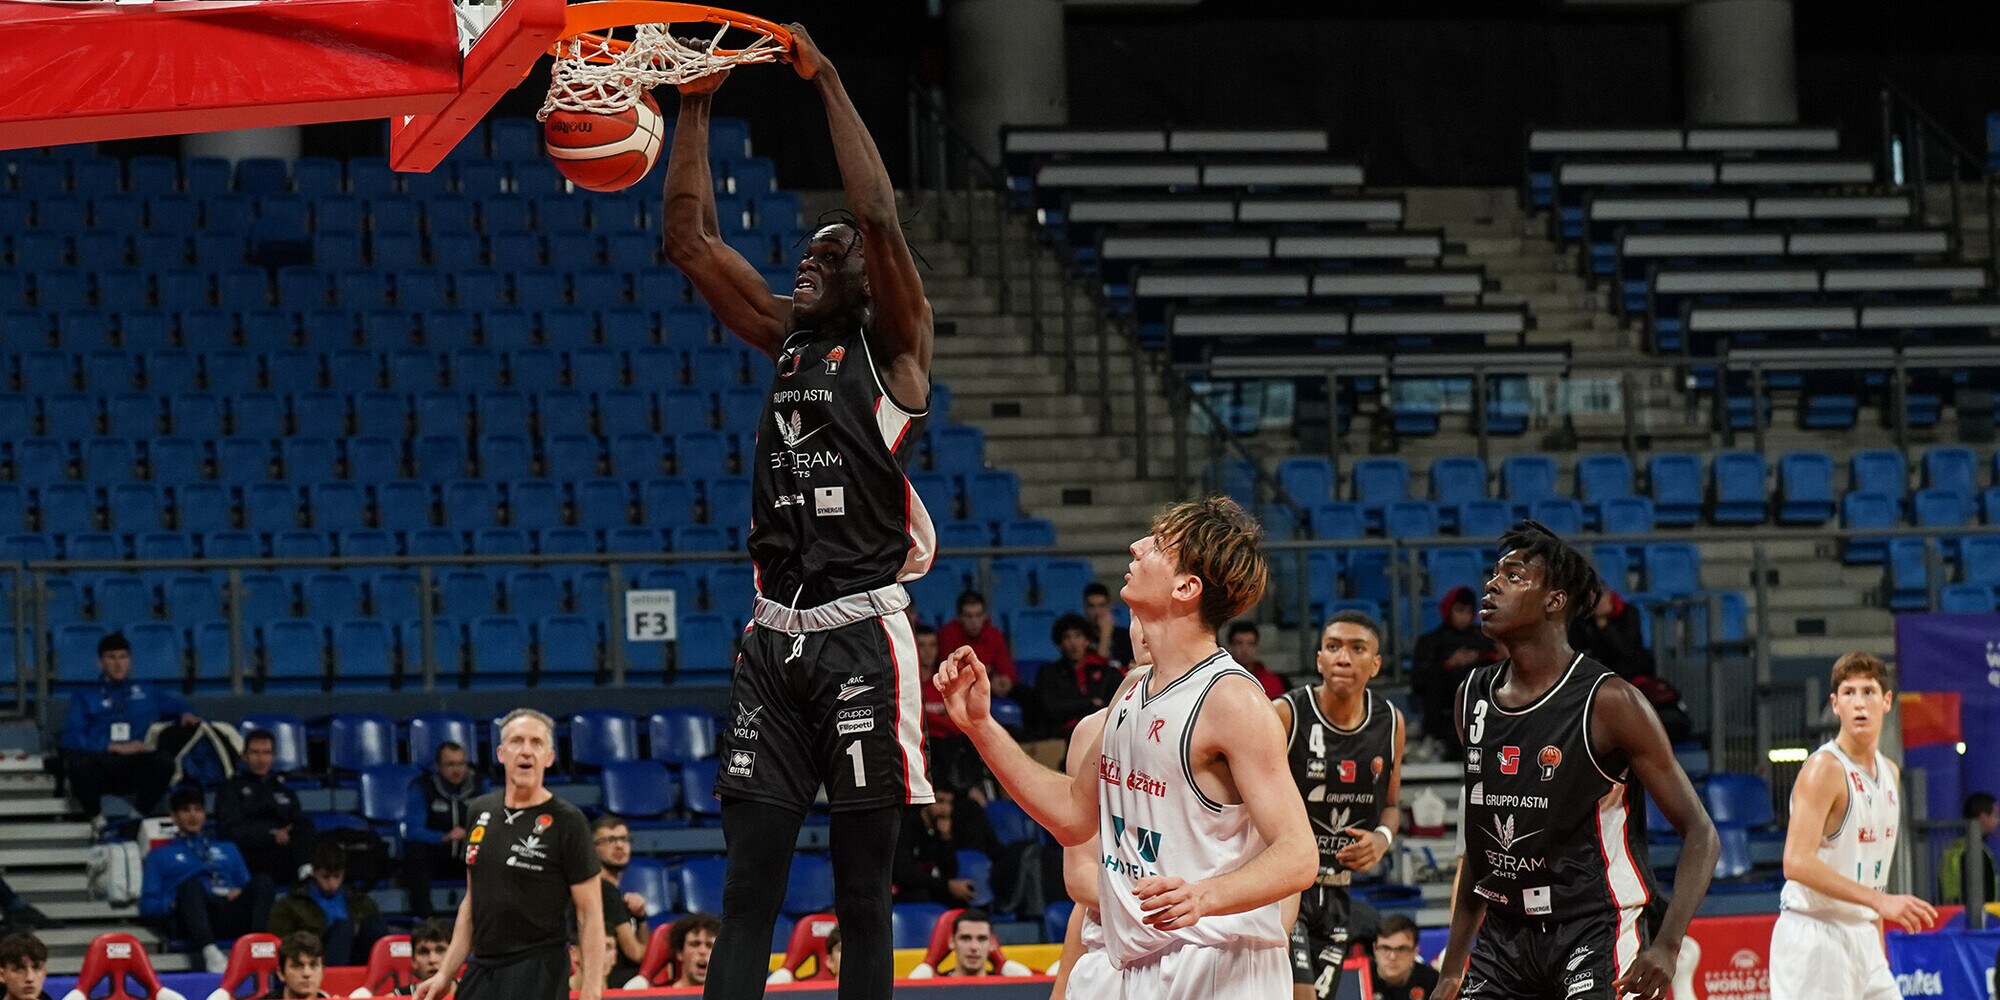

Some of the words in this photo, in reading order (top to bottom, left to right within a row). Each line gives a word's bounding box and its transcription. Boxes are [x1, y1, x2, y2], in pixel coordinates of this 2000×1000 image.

[773, 389, 801, 404] RUPPO
[803, 389, 833, 403] ASTM
[817, 506, 844, 515] SYNERGIE
[635, 612, 668, 636] F3
[838, 708, 872, 719] Gruppo
[1469, 699, 1489, 745] 3
[734, 727, 759, 740] VOLPI
[1309, 723, 1326, 759] 4
[845, 739, 867, 788] 1
[1326, 793, 1355, 803] GRUPPO
[1485, 794, 1519, 807] GRUPPO
[1519, 796, 1549, 809] ASTM
[1526, 905, 1550, 913] SYNERGIE
[1314, 964, 1335, 999] 4
[1564, 971, 1591, 986] Gruppo
[1705, 977, 1756, 993] WORLD
